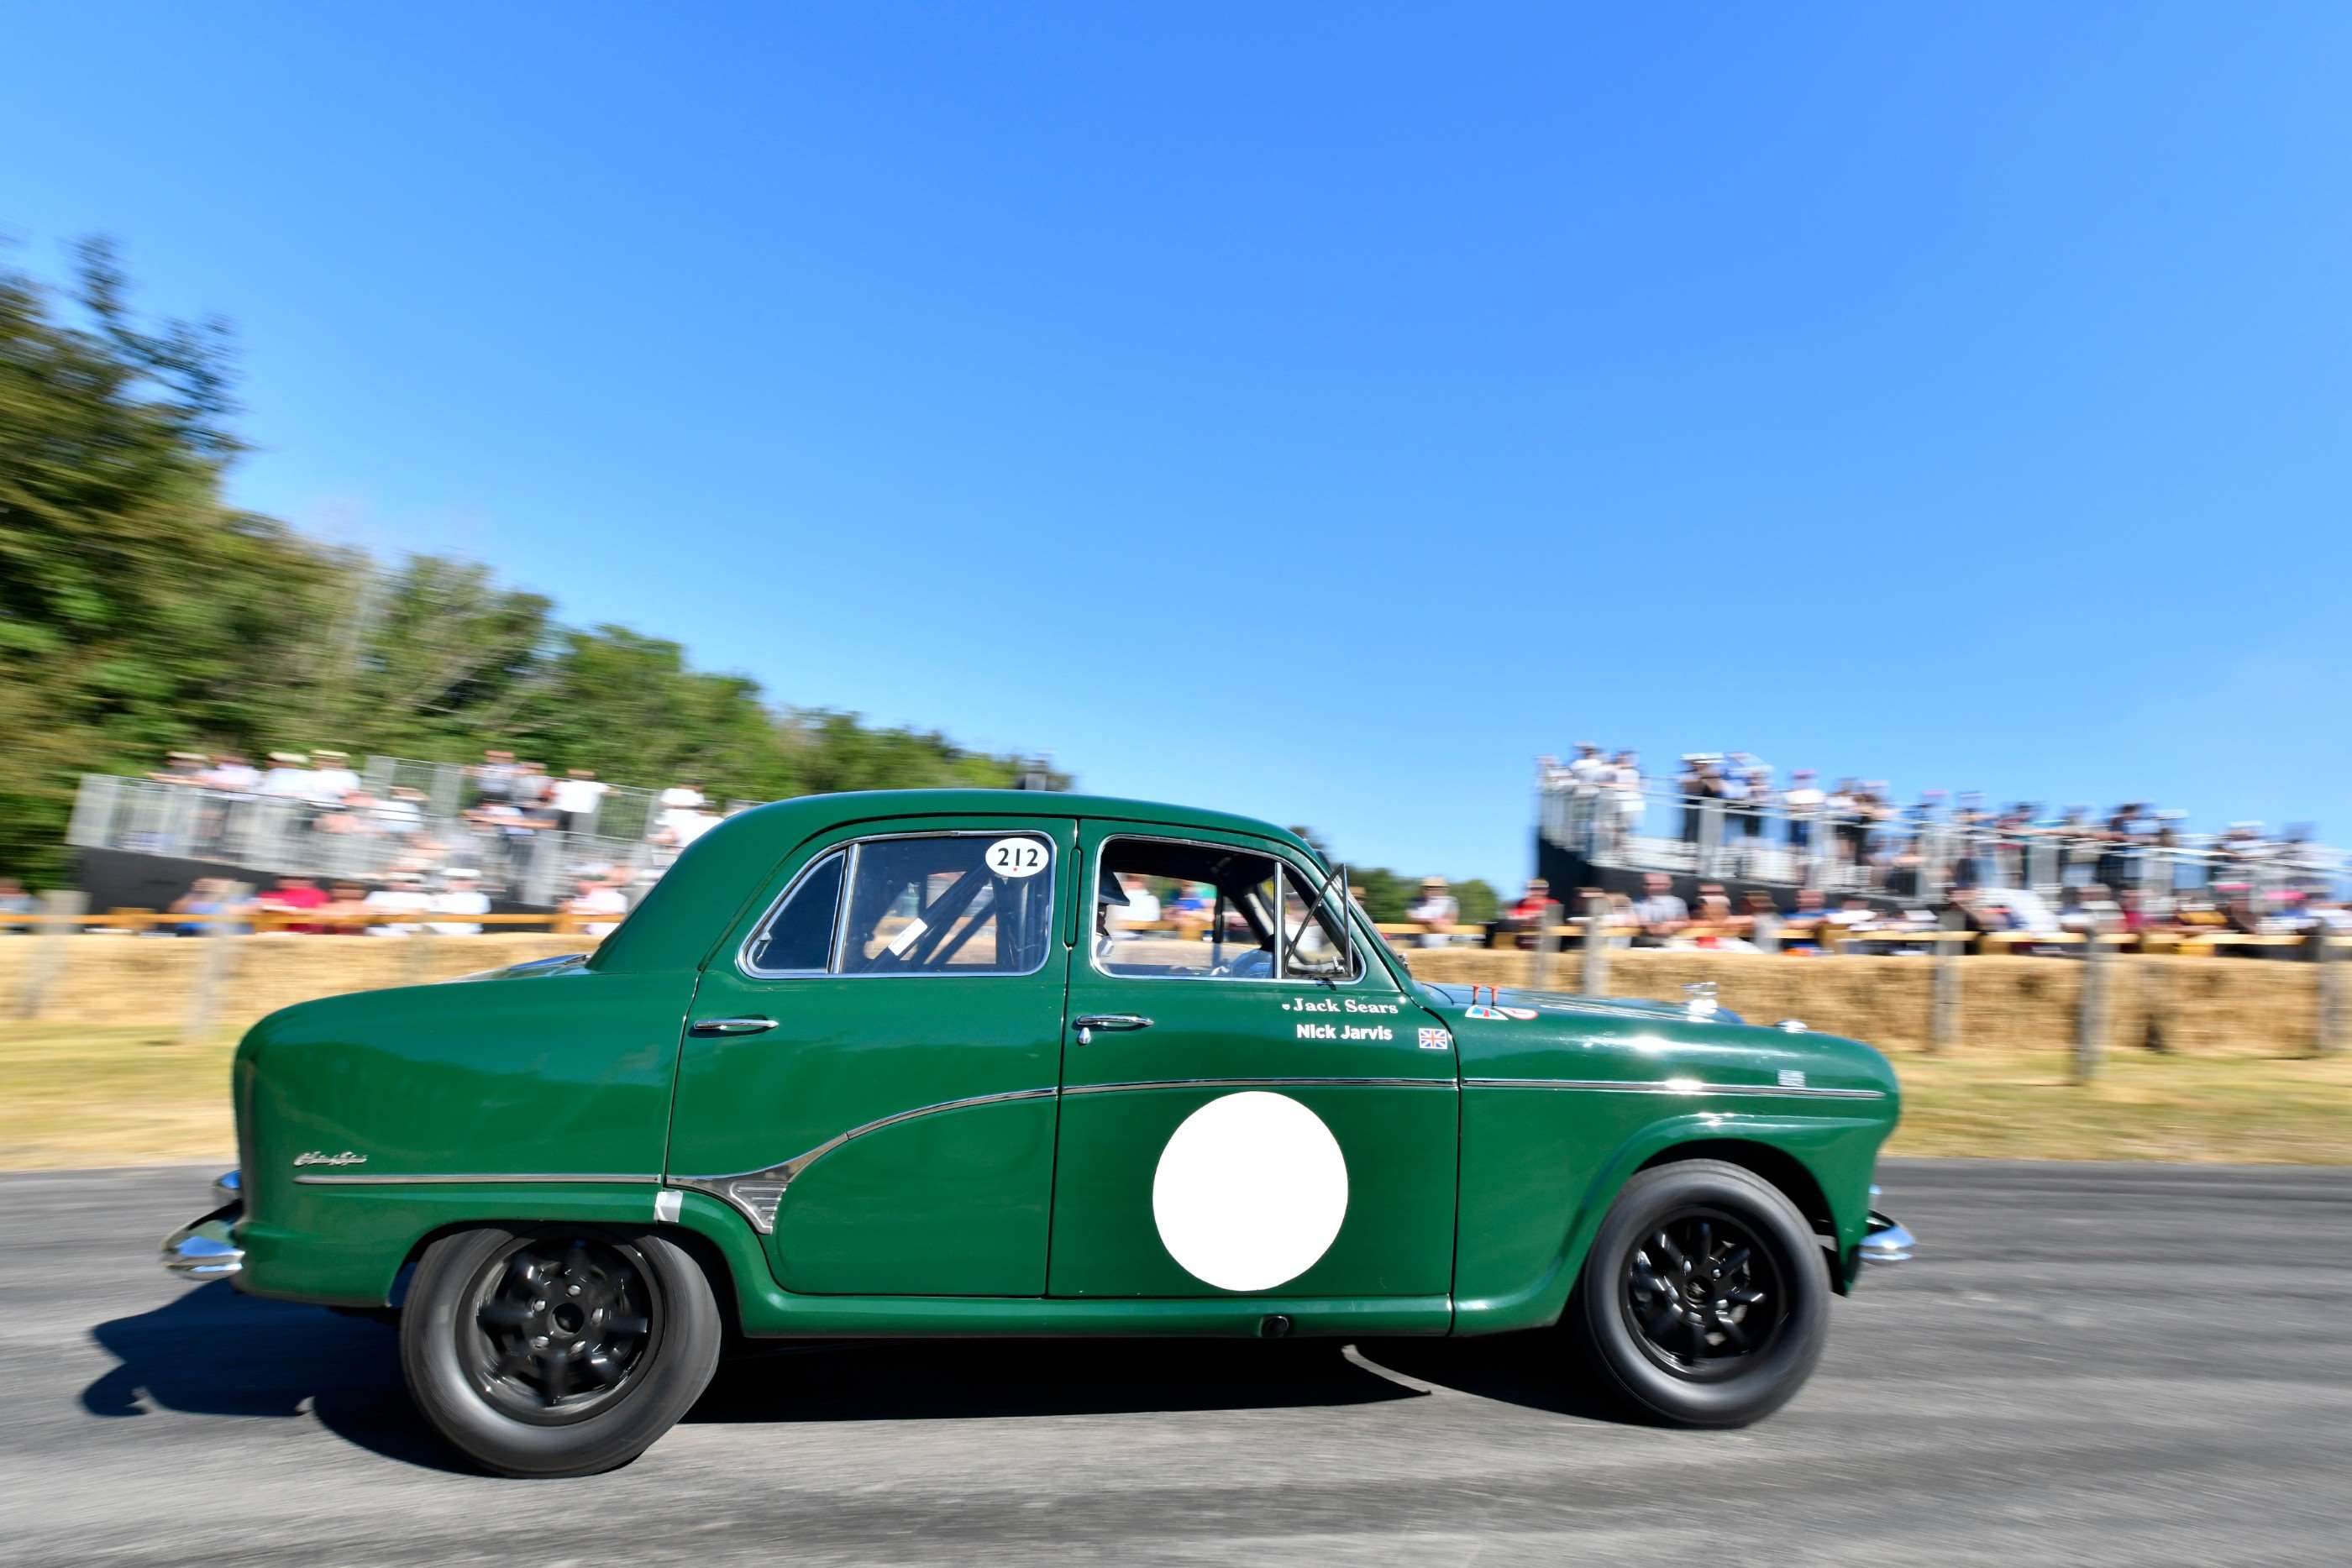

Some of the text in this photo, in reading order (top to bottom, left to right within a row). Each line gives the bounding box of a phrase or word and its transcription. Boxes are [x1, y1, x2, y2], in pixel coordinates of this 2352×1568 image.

[997, 847, 1038, 867] 212
[1294, 998, 1399, 1014] Jack Sears
[1296, 1024, 1393, 1041] Nick Jarvis
